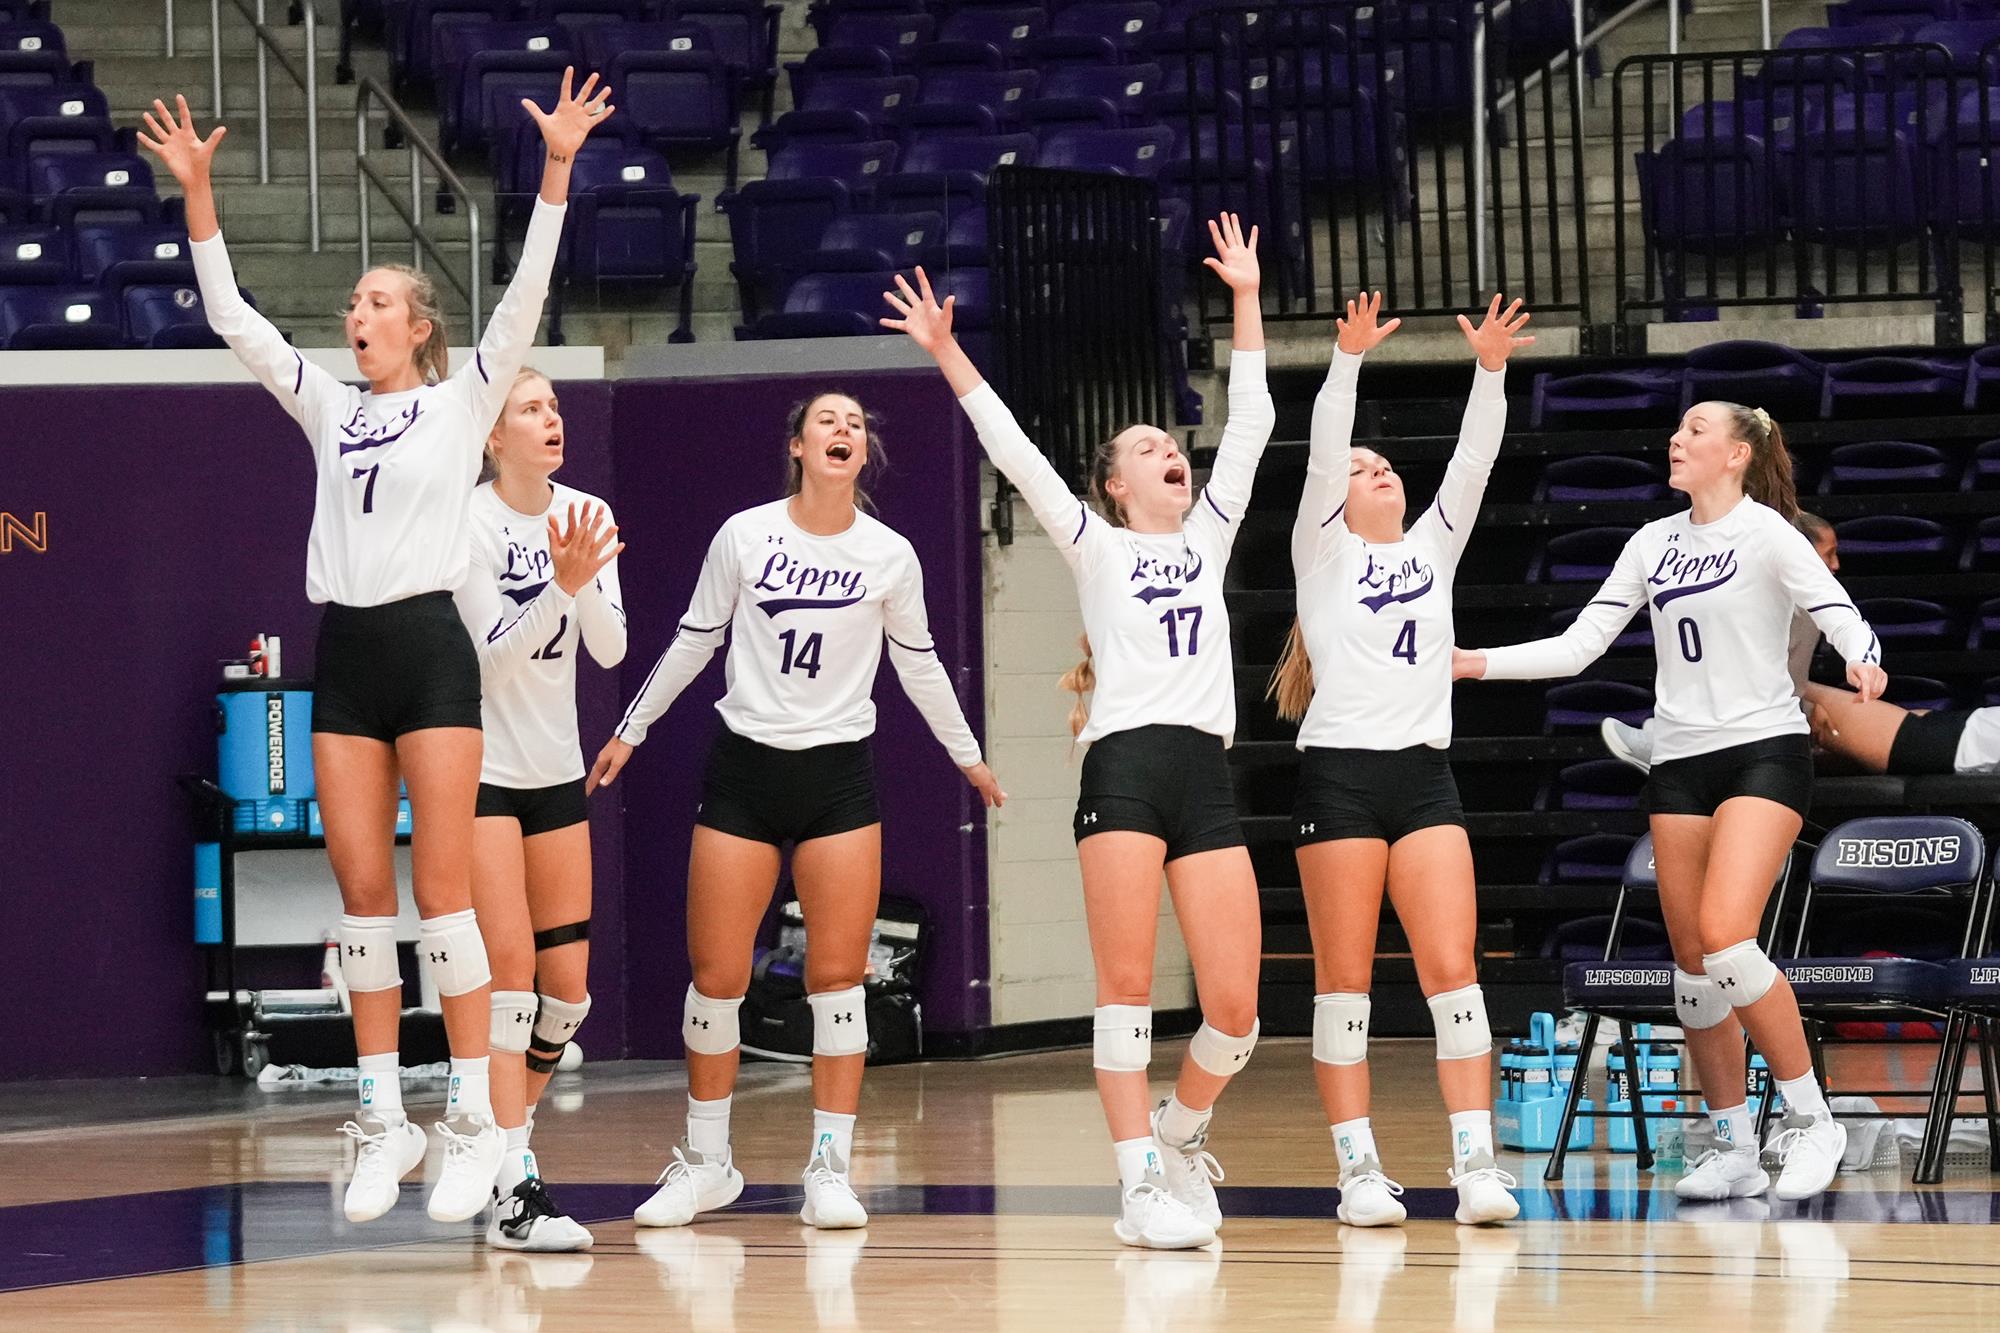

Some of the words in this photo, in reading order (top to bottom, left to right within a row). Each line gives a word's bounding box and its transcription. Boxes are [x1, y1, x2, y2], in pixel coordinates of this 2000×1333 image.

[352, 462, 379, 514] 7
[0, 512, 47, 552] N
[499, 541, 552, 580] Lip
[754, 551, 867, 598] Lippy
[1358, 553, 1434, 593] Lppy
[1647, 548, 1738, 585] Lippy
[530, 614, 566, 660] 2
[778, 628, 823, 679] 14
[1159, 605, 1203, 657] 17
[1392, 620, 1417, 665] 4
[1678, 617, 1702, 663] 0
[268, 698, 284, 792] POWERADE
[1836, 836, 1960, 868] BISONS
[1585, 969, 1671, 986] LIPSCOMB
[1785, 966, 1874, 983] LIPSCOMB
